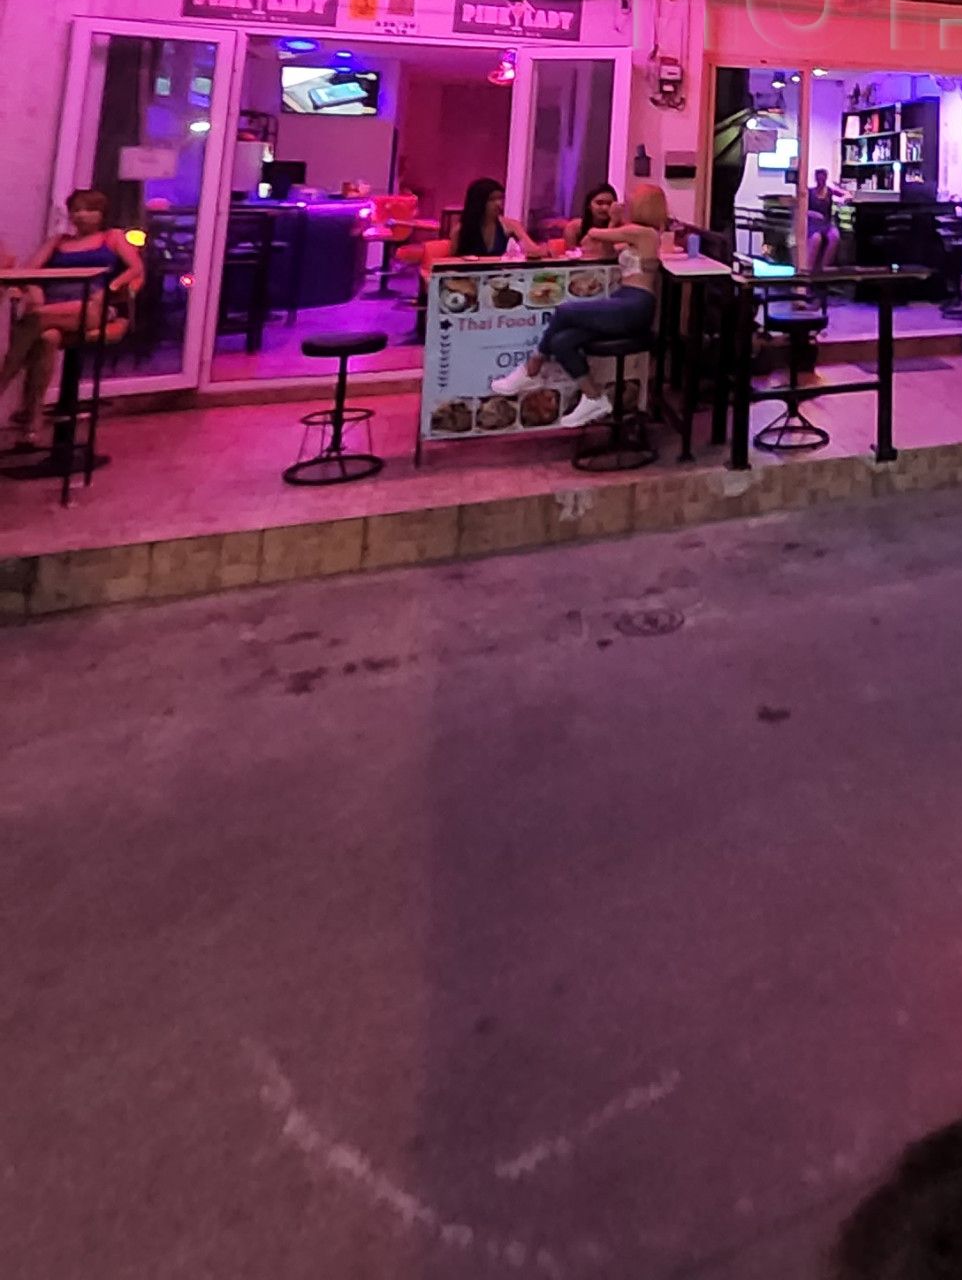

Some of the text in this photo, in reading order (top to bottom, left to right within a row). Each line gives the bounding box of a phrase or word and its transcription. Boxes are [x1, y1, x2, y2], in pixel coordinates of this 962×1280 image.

[523, 8, 574, 30] LADY
[459, 317, 492, 331] Thai
[497, 313, 536, 329] Food
